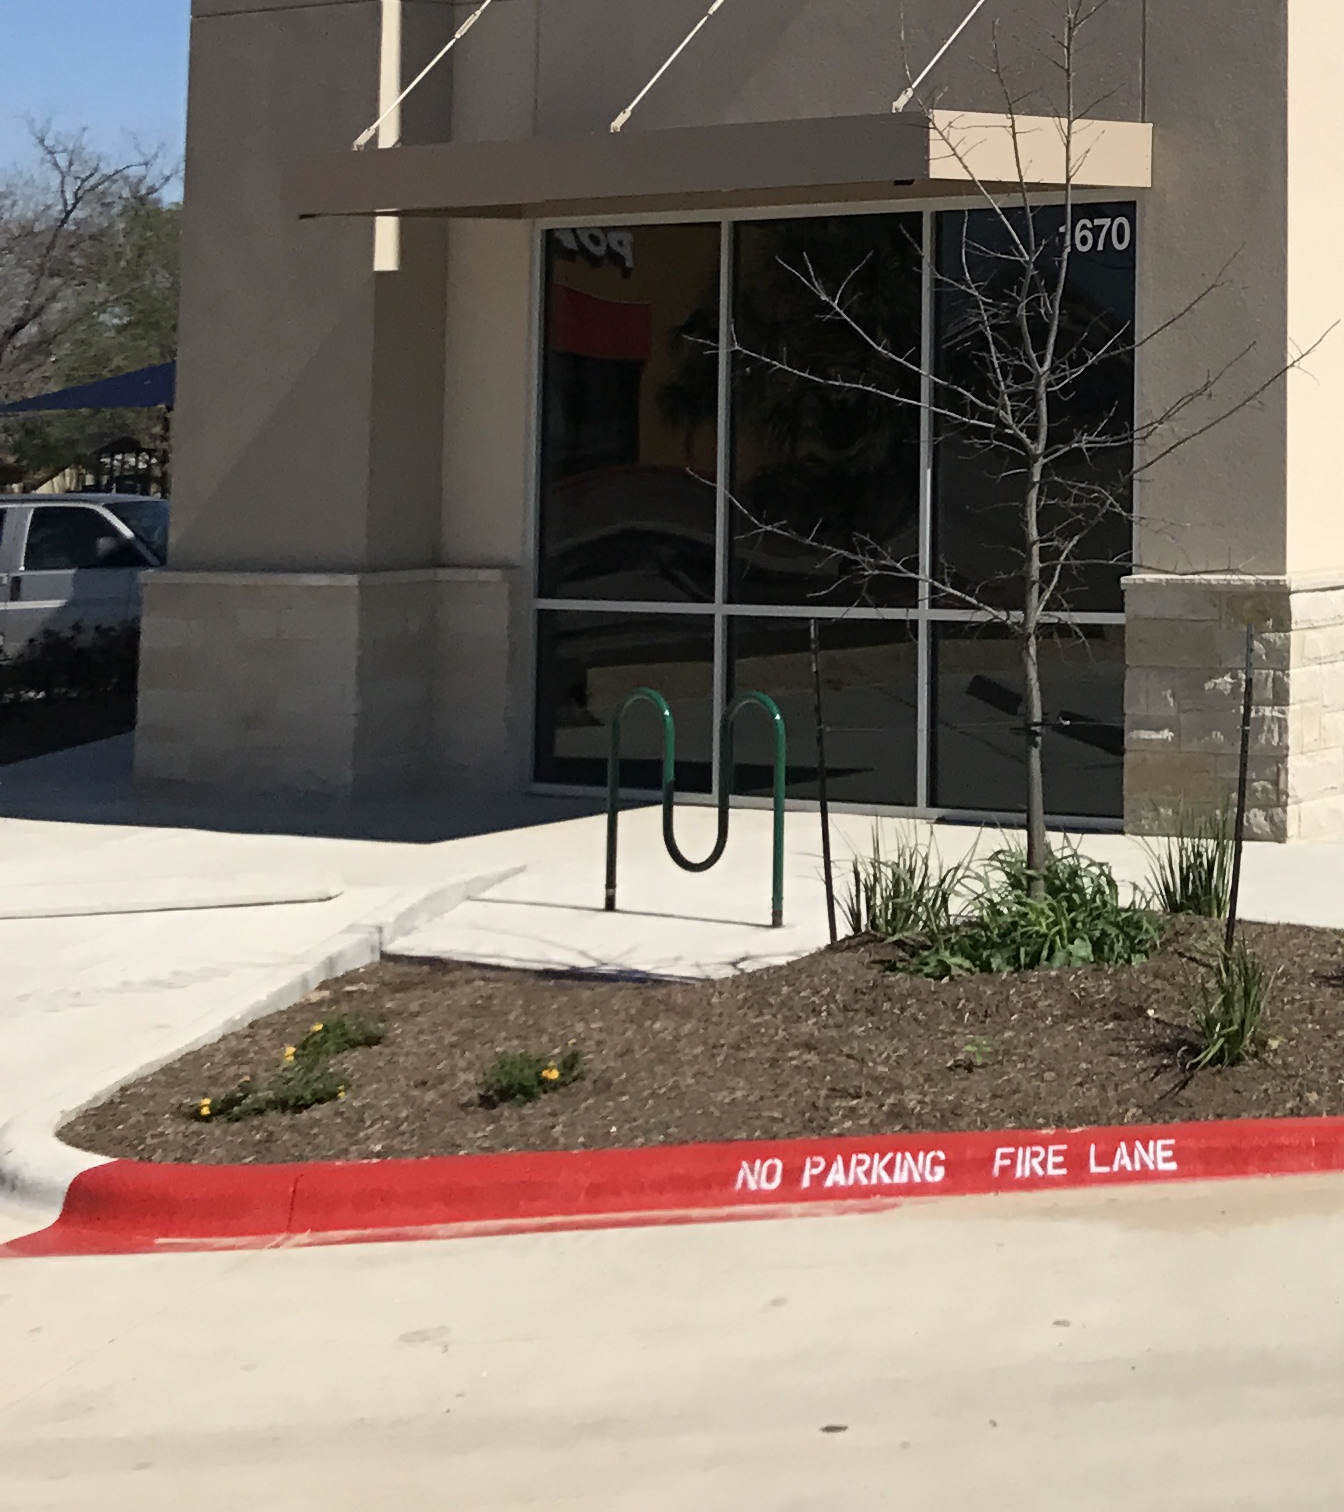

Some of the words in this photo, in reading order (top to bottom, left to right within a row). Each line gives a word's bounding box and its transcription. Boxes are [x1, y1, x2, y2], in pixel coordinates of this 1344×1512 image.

[735, 1158, 784, 1191] NO
[801, 1149, 946, 1188] PARKING
[993, 1144, 1068, 1179] FIRE
[1089, 1138, 1178, 1173] LANE
